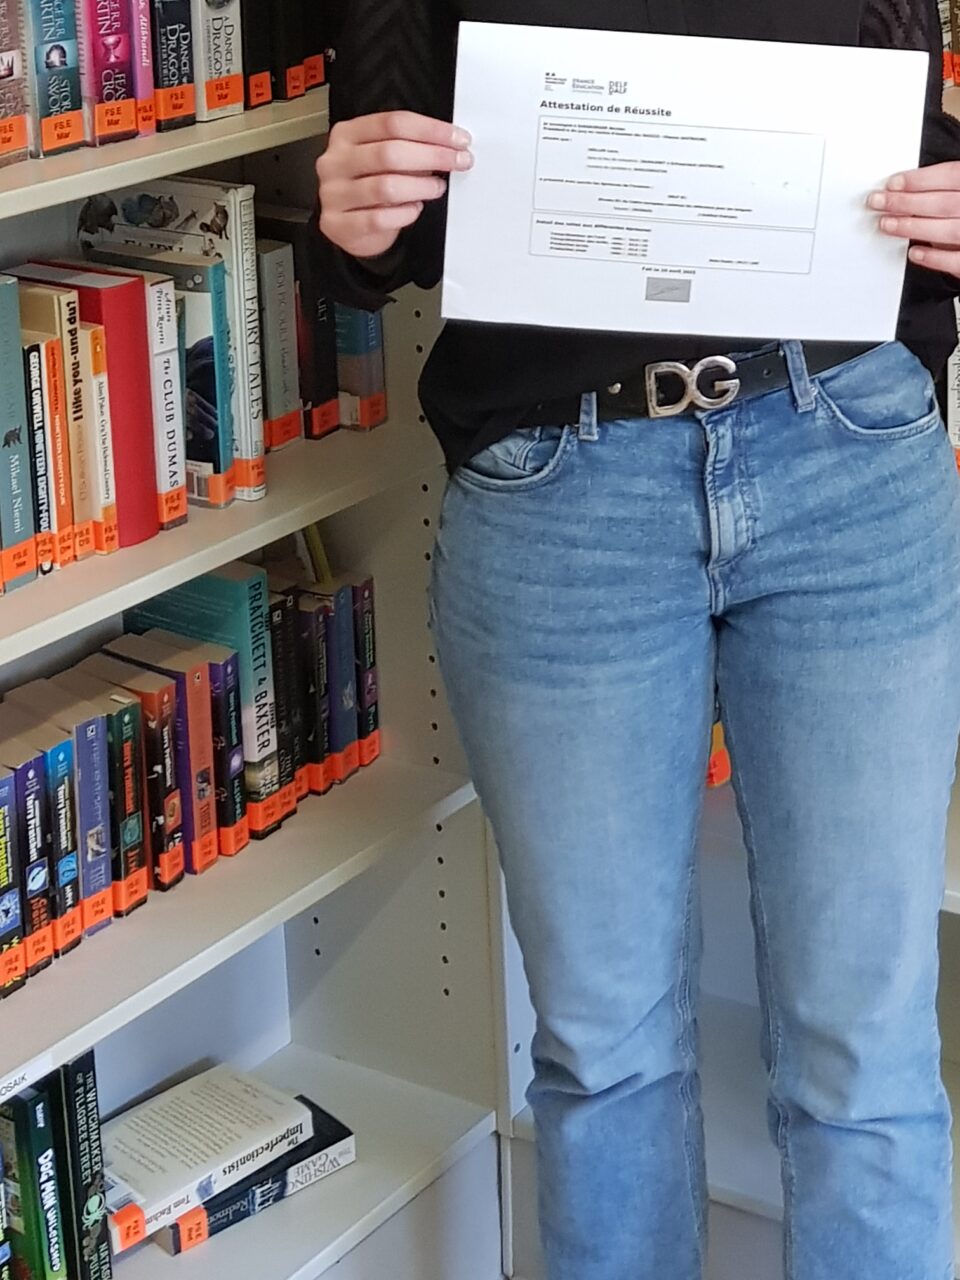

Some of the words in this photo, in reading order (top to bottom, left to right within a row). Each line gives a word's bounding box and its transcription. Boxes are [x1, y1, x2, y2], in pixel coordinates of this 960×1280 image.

[539, 100, 604, 112] Attestation
[607, 104, 621, 113] de
[624, 106, 672, 117] Réussite
[246, 297, 258, 345] FAIRY
[162, 358, 170, 375] The
[645, 355, 741, 418] DG
[163, 379, 174, 422] CLUB
[249, 359, 262, 420] TALES
[8, 454, 19, 494] Mikael
[166, 429, 179, 488] DUMAS
[11, 497, 23, 534] Niemi
[248, 580, 266, 670] PRATCHETT
[257, 677, 266, 687] &
[254, 690, 270, 753] BAXTER
[85, 1071, 93, 1085] THE
[74, 1087, 89, 1142] FILIGREE
[88, 1087, 102, 1172] WATCHMAKER
[39, 1149, 51, 1179] DOG
[80, 1143, 90, 1186] STREET
[221, 1122, 303, 1176] Imperfectionists
[44, 1180, 56, 1207] MAN
[48, 1209, 61, 1272] UNLEASHED
